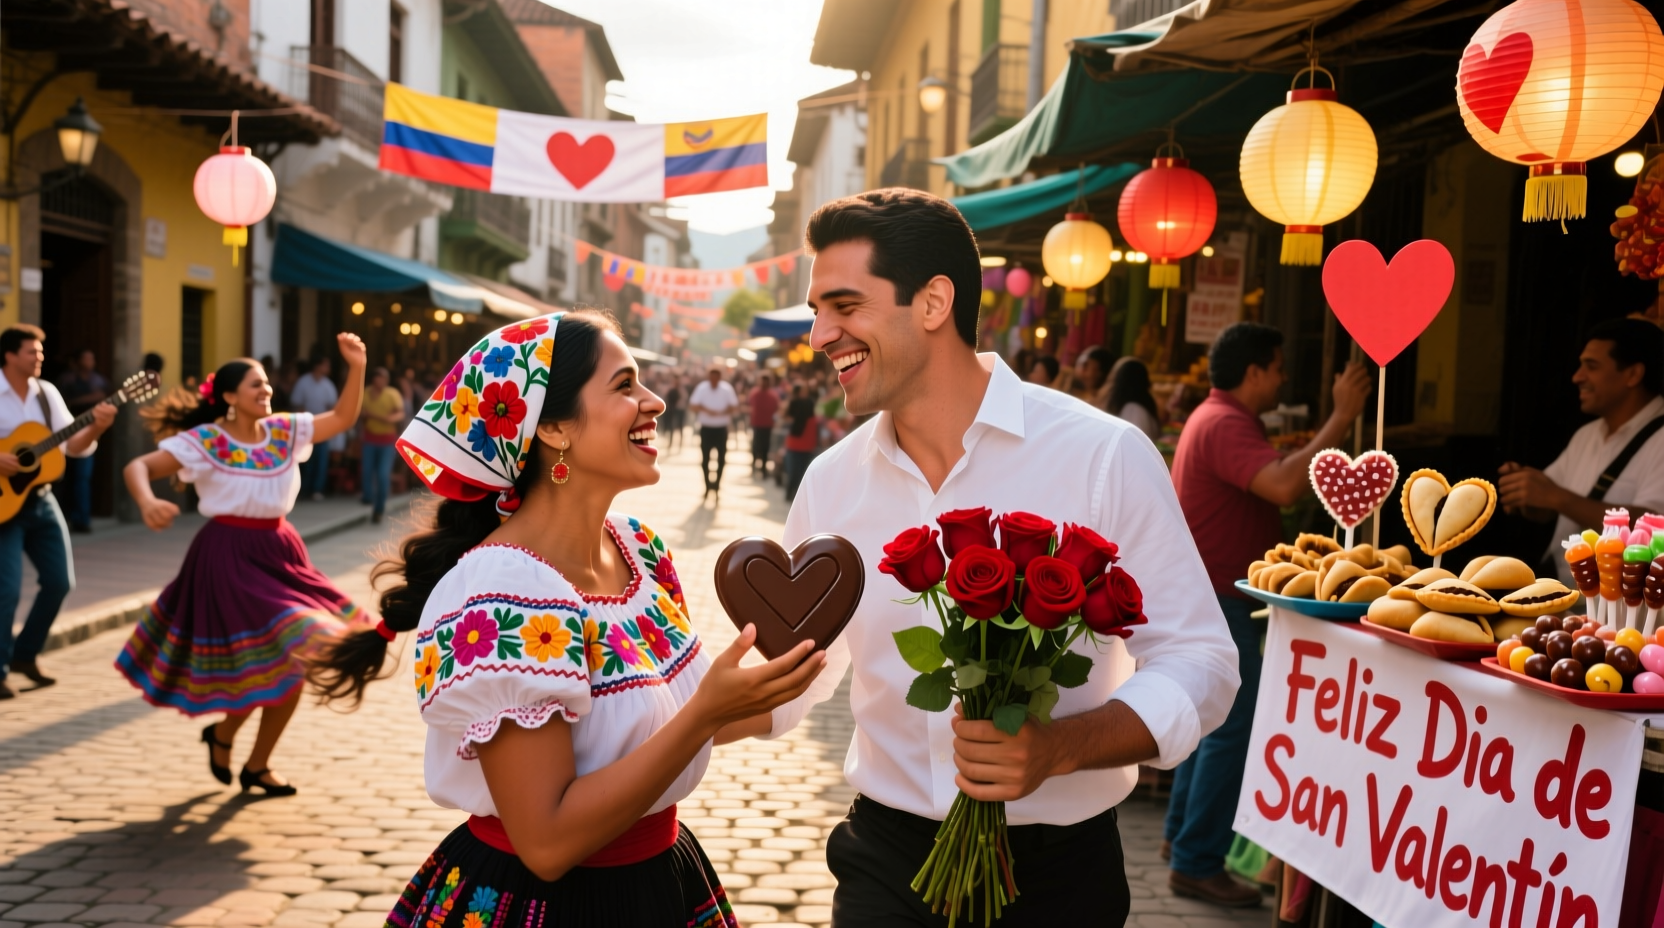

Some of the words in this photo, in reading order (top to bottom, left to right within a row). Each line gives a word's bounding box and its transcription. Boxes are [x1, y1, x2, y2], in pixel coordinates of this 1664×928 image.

[1254, 733, 1349, 848] San
[1366, 772, 1600, 928] Valentín
[1286, 639, 1401, 760] Feliz
[1417, 680, 1515, 803] Dia
[1533, 723, 1612, 840] de
